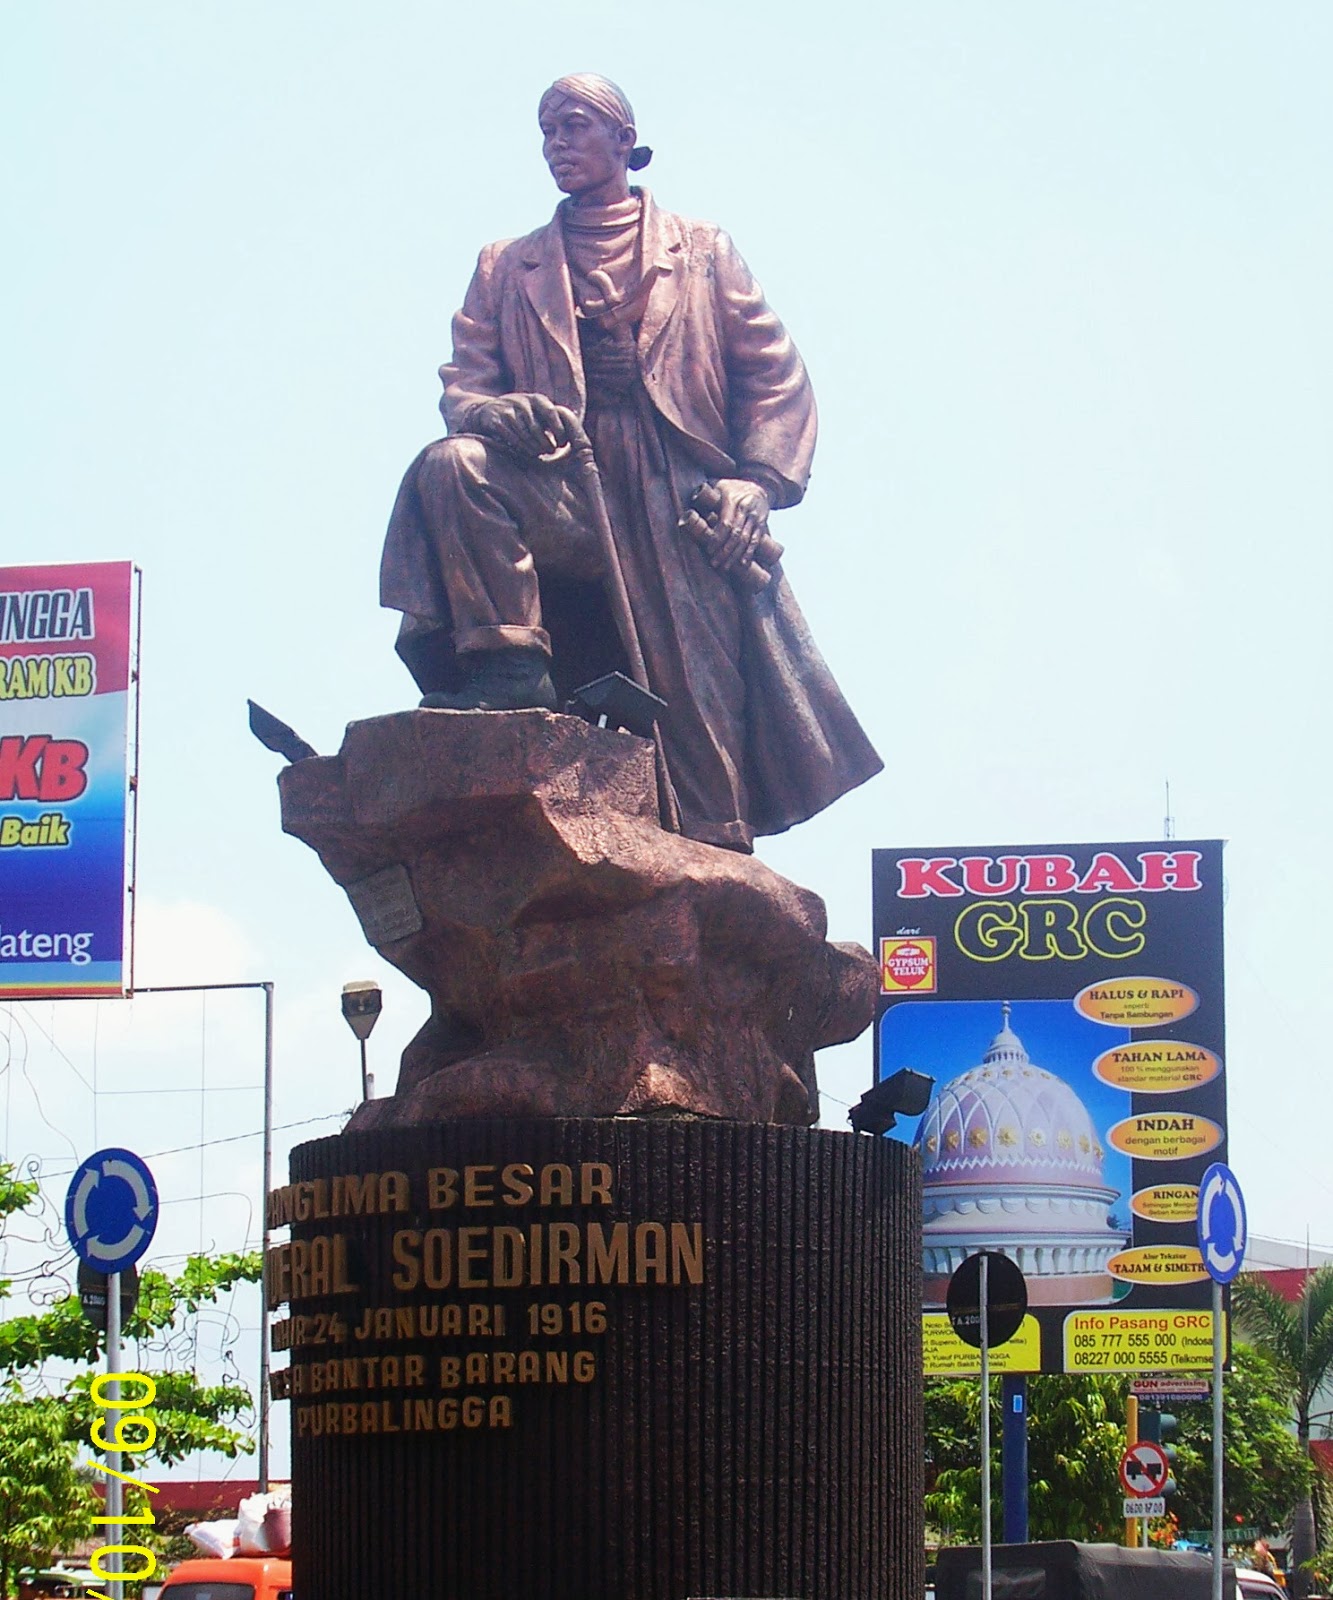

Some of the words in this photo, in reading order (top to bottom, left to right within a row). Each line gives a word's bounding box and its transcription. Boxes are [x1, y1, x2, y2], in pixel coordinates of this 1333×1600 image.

[52, 656, 93, 698] KB
[0, 735, 88, 802] KB
[0, 814, 71, 846] Baik
[897, 851, 1203, 898] KUBAH
[954, 897, 1146, 962] GRC
[0, 925, 94, 966] ateng
[888, 956, 929, 967] GYPSUM
[893, 966, 925, 976] TELUK
[1090, 989, 1134, 1000] HALUS
[1137, 989, 1148, 999] &
[1150, 988, 1184, 998] RAPI
[1100, 1011, 1125, 1020] Tanpa
[1126, 1010, 1173, 1019] Sambungan
[1112, 1052, 1162, 1063] TAHAN
[1166, 1051, 1207, 1061] LAMA
[1145, 1065, 1199, 1074] menggunakan
[1149, 1074, 1181, 1082] material
[1182, 1073, 1202, 1081] GRC
[1136, 1118, 1194, 1131] INDAH
[1125, 1137, 1161, 1146] dengan
[1163, 1135, 1206, 1145] berbagai
[1153, 1147, 1178, 1155] motif
[267, 1171, 409, 1229] ANGLIMA
[428, 1162, 613, 1210] BESAR
[1153, 1190, 1199, 1199] RINGAN
[392, 1222, 705, 1291] SOEDIRMAN
[1113, 1263, 1150, 1273] TAJAM
[1153, 1263, 1162, 1272] &
[313, 1312, 341, 1343] 24
[355, 1304, 506, 1340] JANUARI
[527, 1301, 607, 1335] 1916
[1074, 1317, 1104, 1330] Info
[1109, 1316, 1168, 1332] Pasang
[1173, 1315, 1210, 1328] GRC
[1074, 1335, 1096, 1348] 085
[1101, 1334, 1122, 1347] 777
[1128, 1334, 1150, 1347] 555
[1155, 1333, 1176, 1346] 000
[1181, 1335, 1213, 1348] (Indosa
[1074, 1352, 1109, 1366] 08227
[1113, 1351, 1135, 1365] 000
[1139, 1351, 1167, 1364] 5555
[1170, 1352, 1213, 1366] (Telkomse
[311, 1354, 425, 1393] BANTAR
[441, 1350, 596, 1390] BARANG
[1133, 1380, 1158, 1388] GUN
[1160, 1379, 1206, 1388] advertising
[296, 1395, 512, 1438] PURBALINGGA
